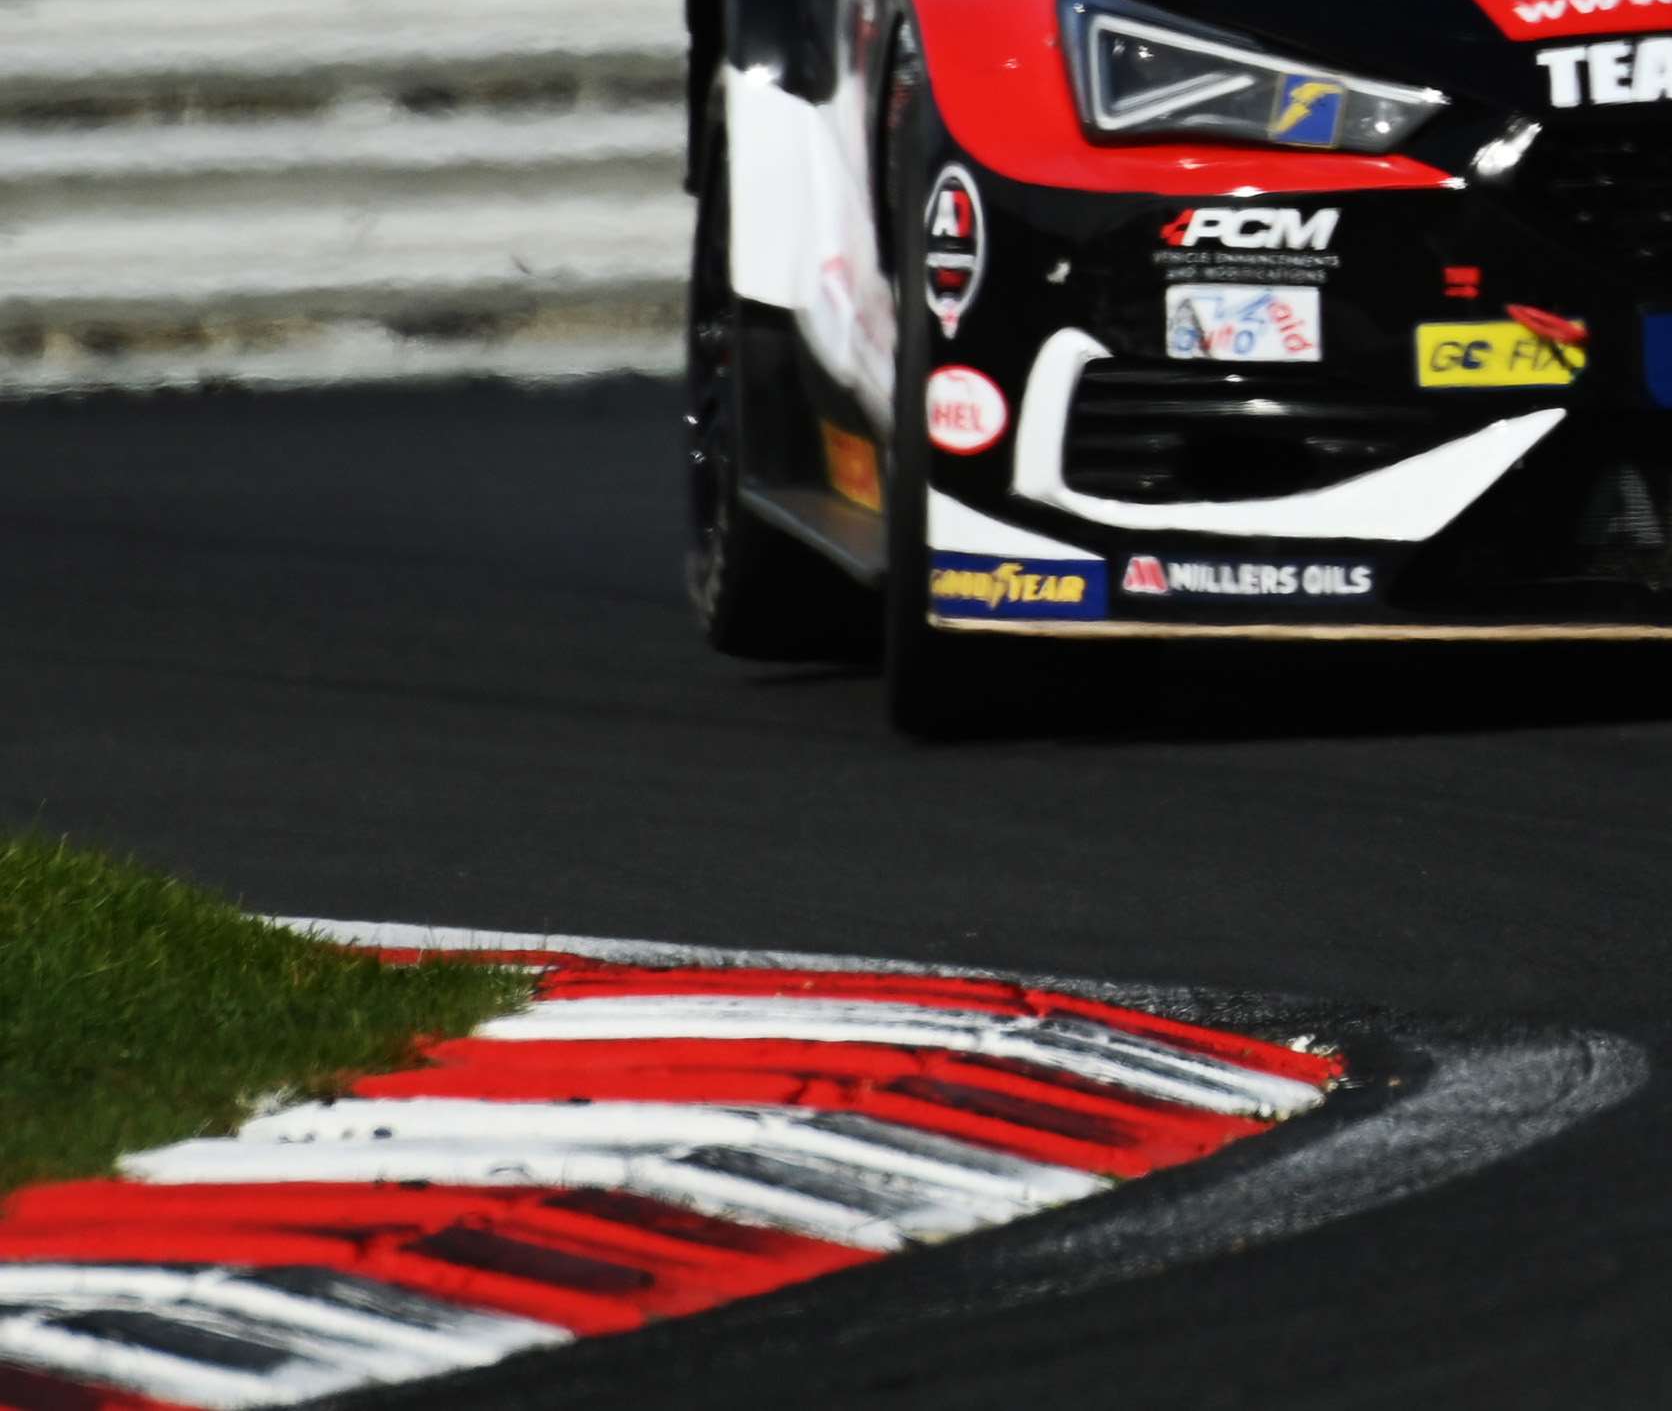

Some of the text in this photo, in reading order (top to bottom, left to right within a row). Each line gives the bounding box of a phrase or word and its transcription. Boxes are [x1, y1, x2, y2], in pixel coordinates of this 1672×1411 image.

[931, 401, 988, 433] HEL
[1168, 563, 1372, 594] MILLERS OILS
